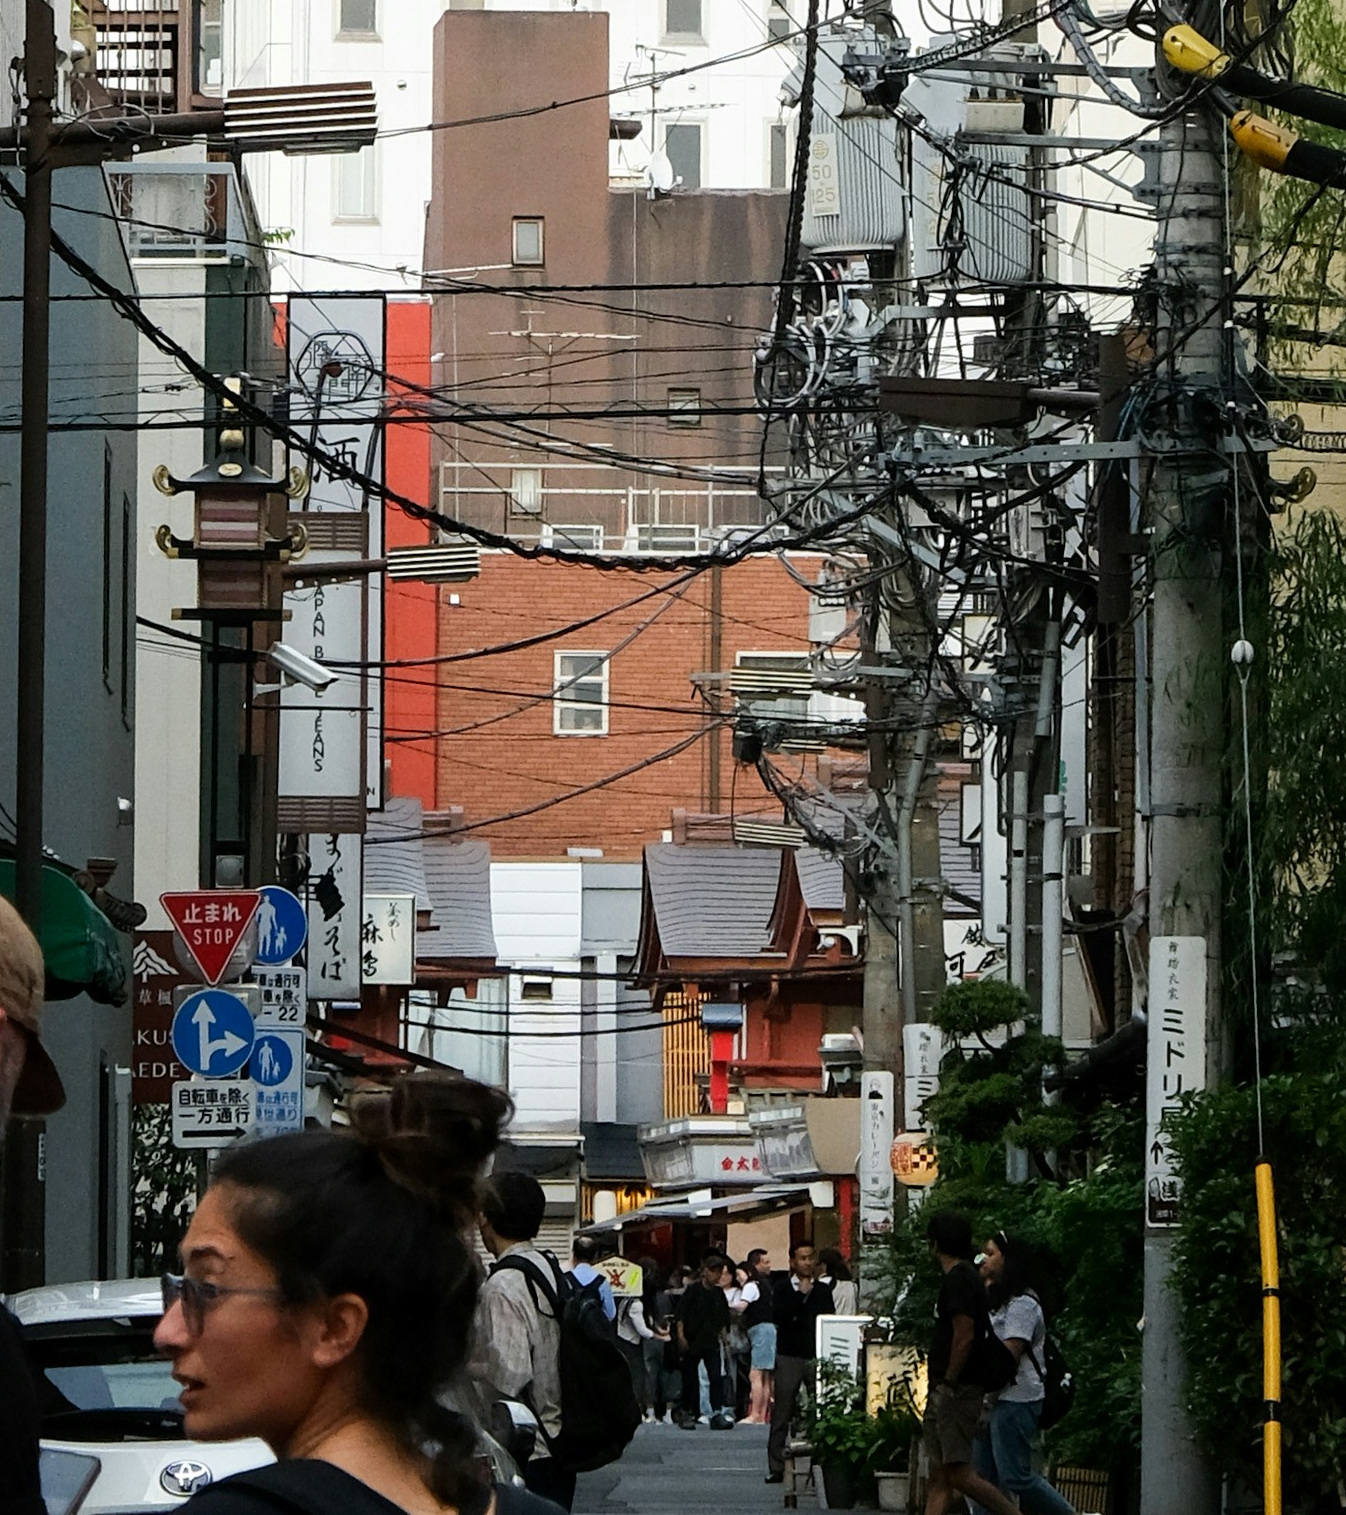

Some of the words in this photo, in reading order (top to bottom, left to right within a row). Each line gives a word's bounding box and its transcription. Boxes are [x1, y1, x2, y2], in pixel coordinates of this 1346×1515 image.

[812, 165, 832, 180] 50
[313, 585, 325, 637] APAN
[182, 903, 242, 923] 止まれ
[193, 927, 234, 946] STOP
[178, 1087, 250, 1106] 自転車を除く
[179, 1107, 250, 1125] 一方通行
